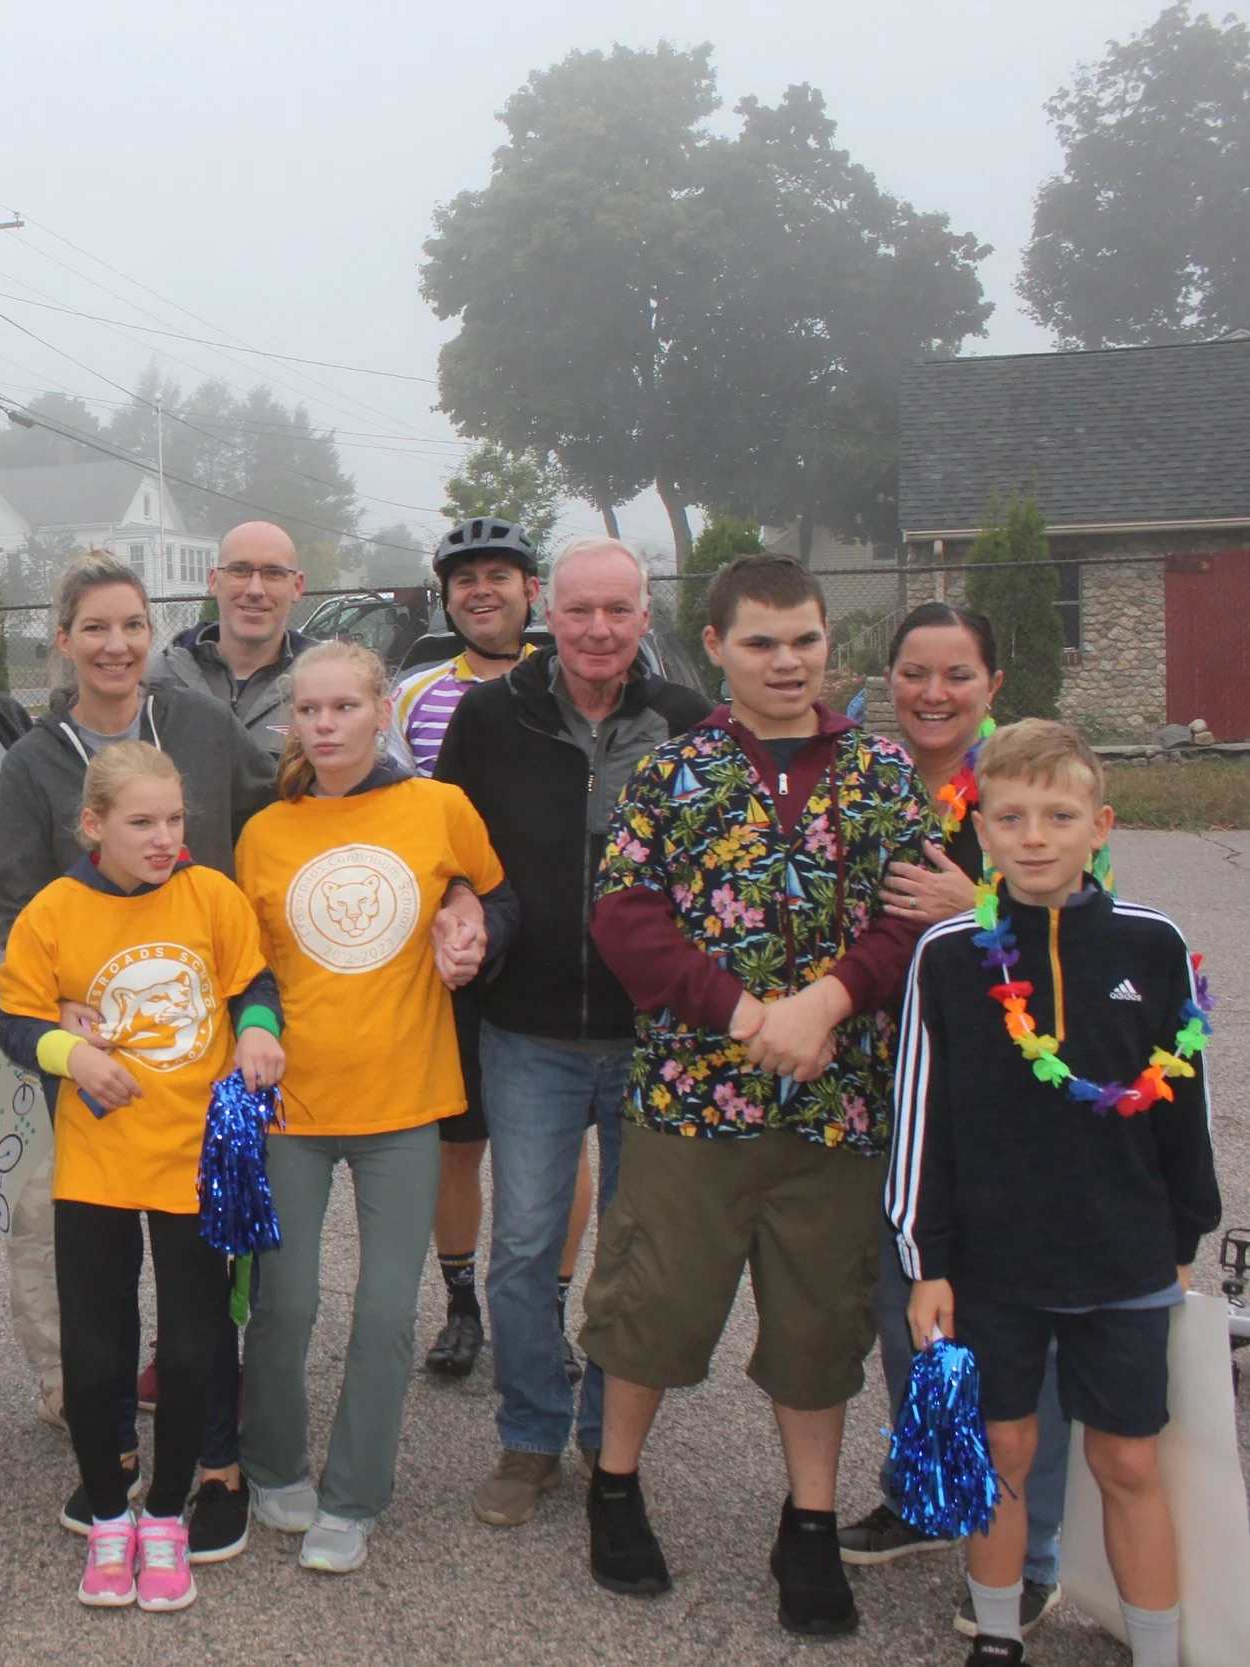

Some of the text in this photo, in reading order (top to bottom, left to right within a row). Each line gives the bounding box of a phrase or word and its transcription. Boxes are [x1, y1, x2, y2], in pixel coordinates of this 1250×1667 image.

[295, 852, 412, 938] Crossroads Continuum School
[91, 947, 212, 1008] SSROADS SCHOO
[1109, 989, 1143, 1002] adidas
